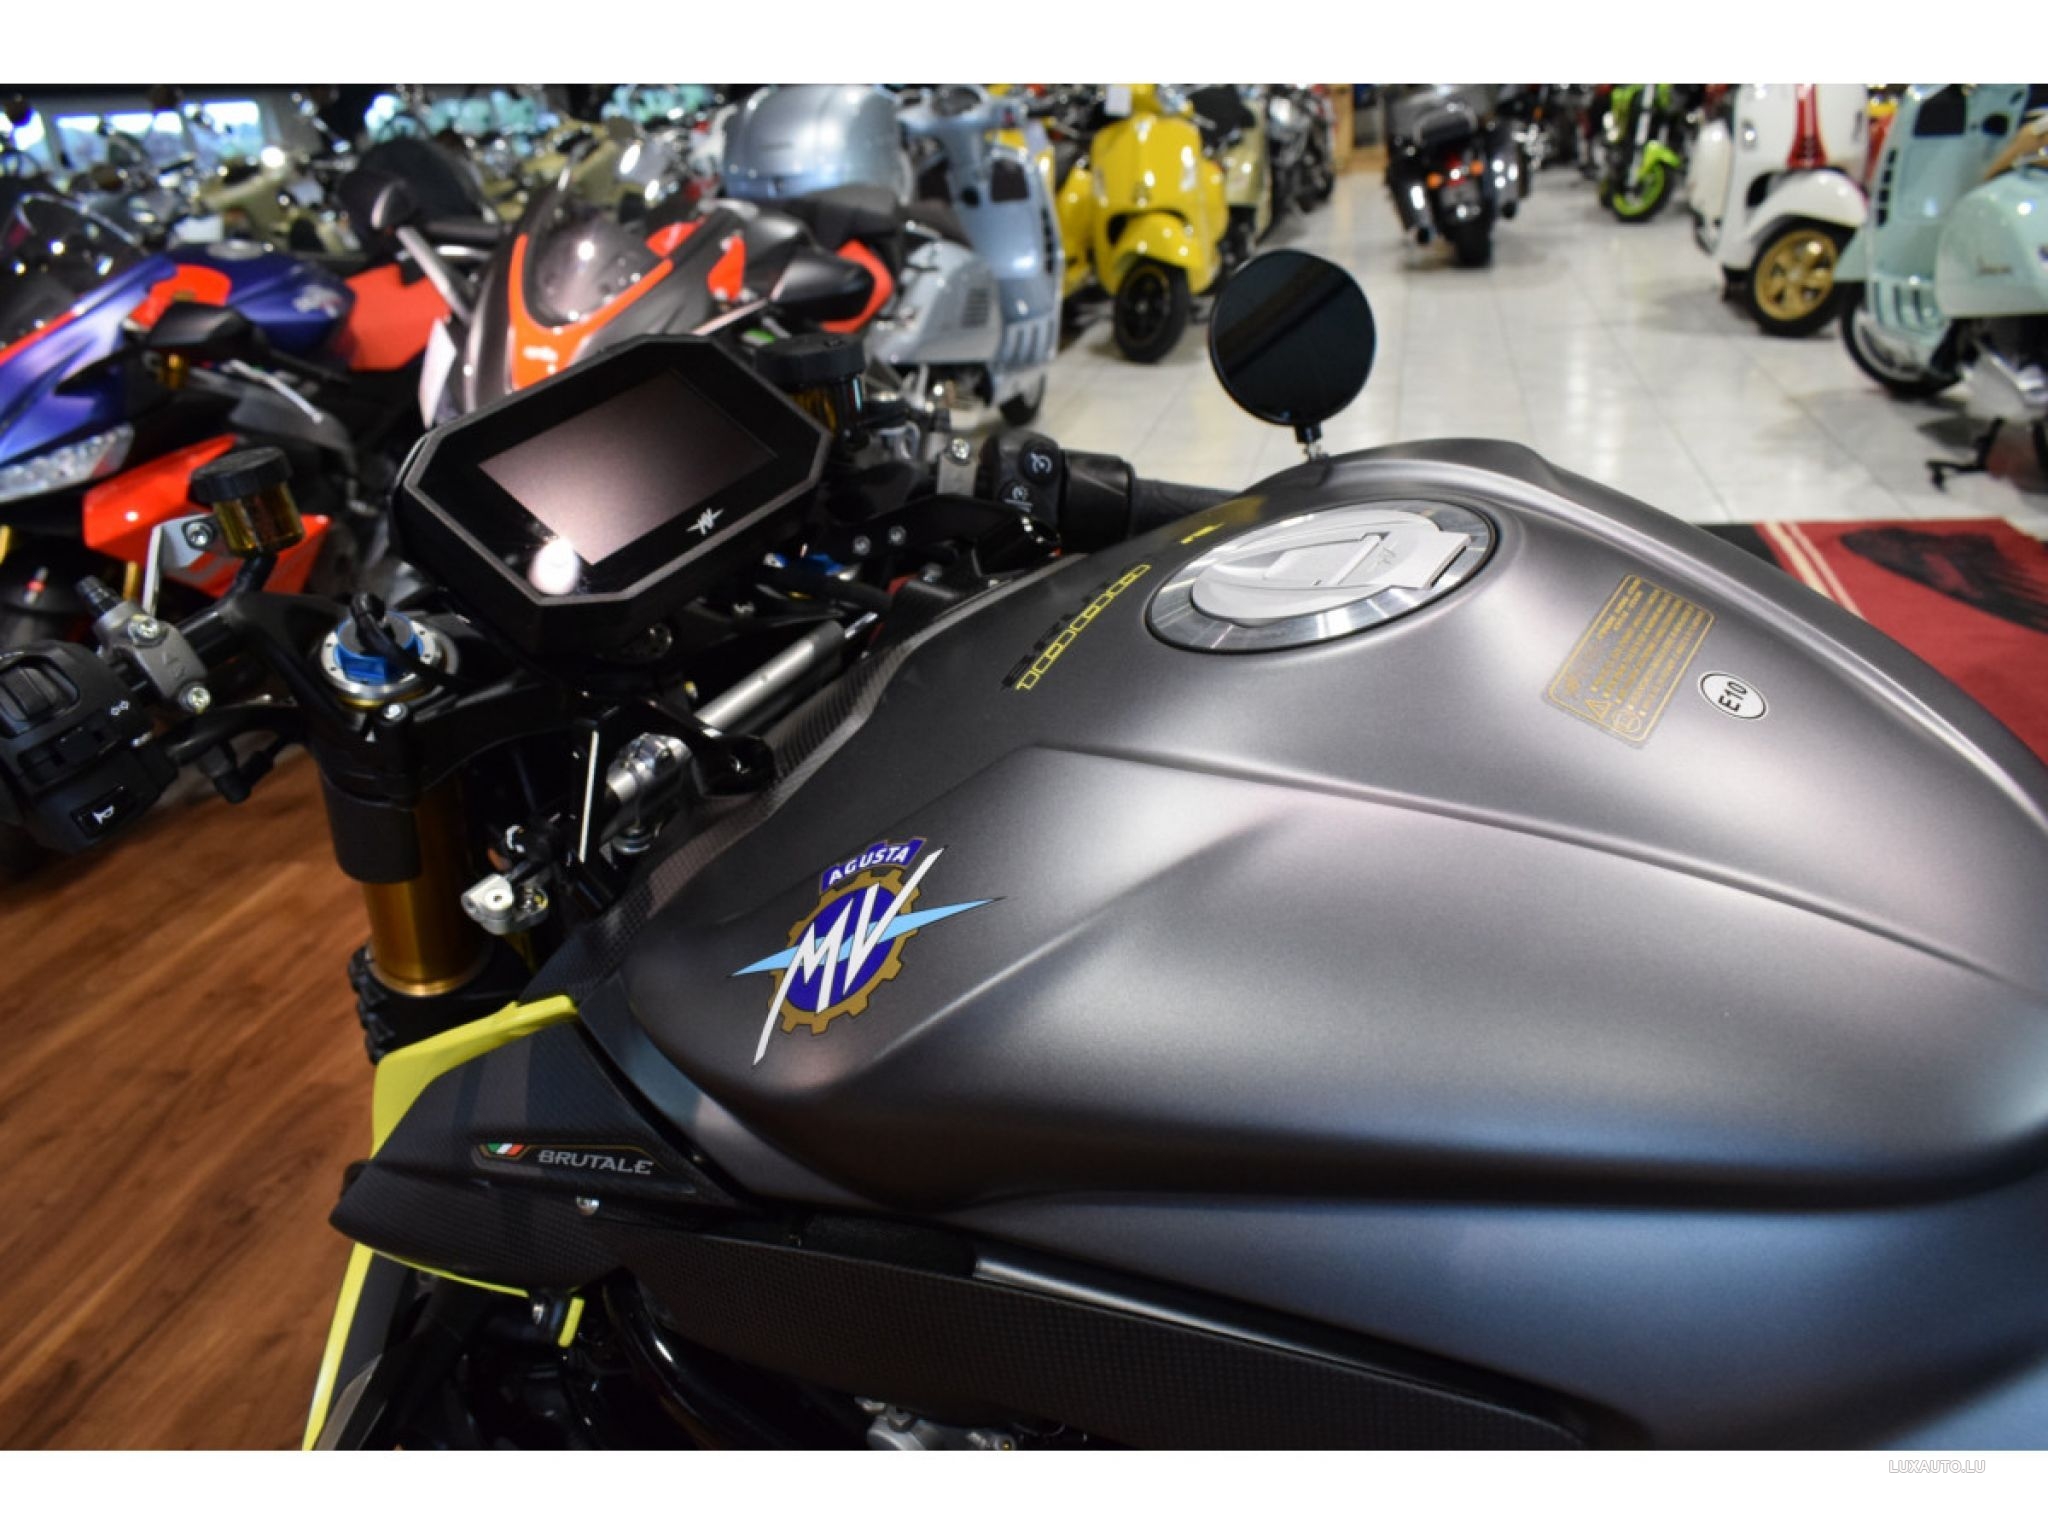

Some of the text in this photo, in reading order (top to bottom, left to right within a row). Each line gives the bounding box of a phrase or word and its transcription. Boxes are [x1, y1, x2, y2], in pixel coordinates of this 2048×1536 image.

[1717, 680, 1748, 713] E10
[828, 845, 910, 886] AGUSTA
[538, 1149, 655, 1175] BRUTALE
